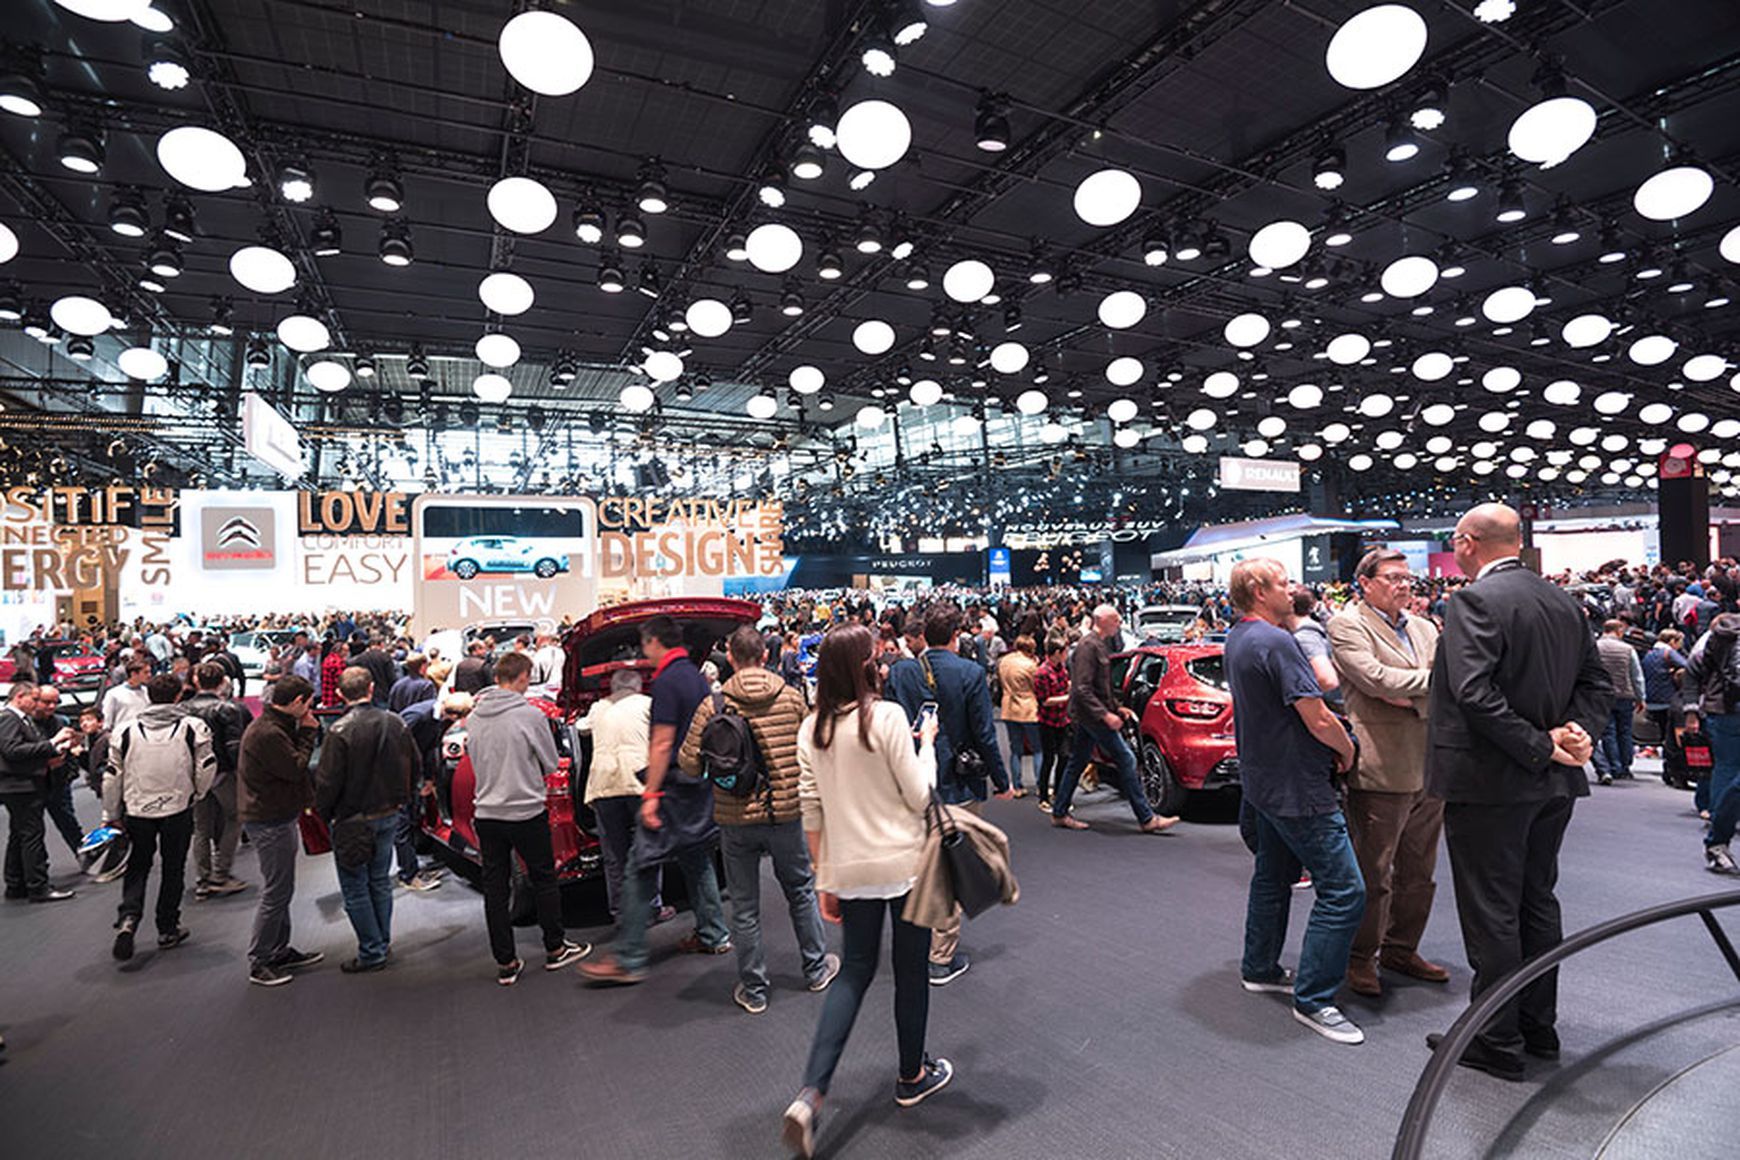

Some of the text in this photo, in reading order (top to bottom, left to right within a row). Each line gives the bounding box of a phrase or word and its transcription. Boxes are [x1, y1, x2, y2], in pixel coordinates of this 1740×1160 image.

[0, 486, 134, 523] SITIF
[301, 491, 407, 532] LOVE
[599, 497, 755, 528] CREATIVE
[141, 487, 174, 586] SMILE
[302, 534, 407, 550] COMFORT
[600, 531, 755, 578] DESIGN
[759, 497, 784, 575] SHARE
[3, 548, 130, 590] ERGY
[304, 553, 408, 585] EASY
[459, 585, 557, 618] NEW
